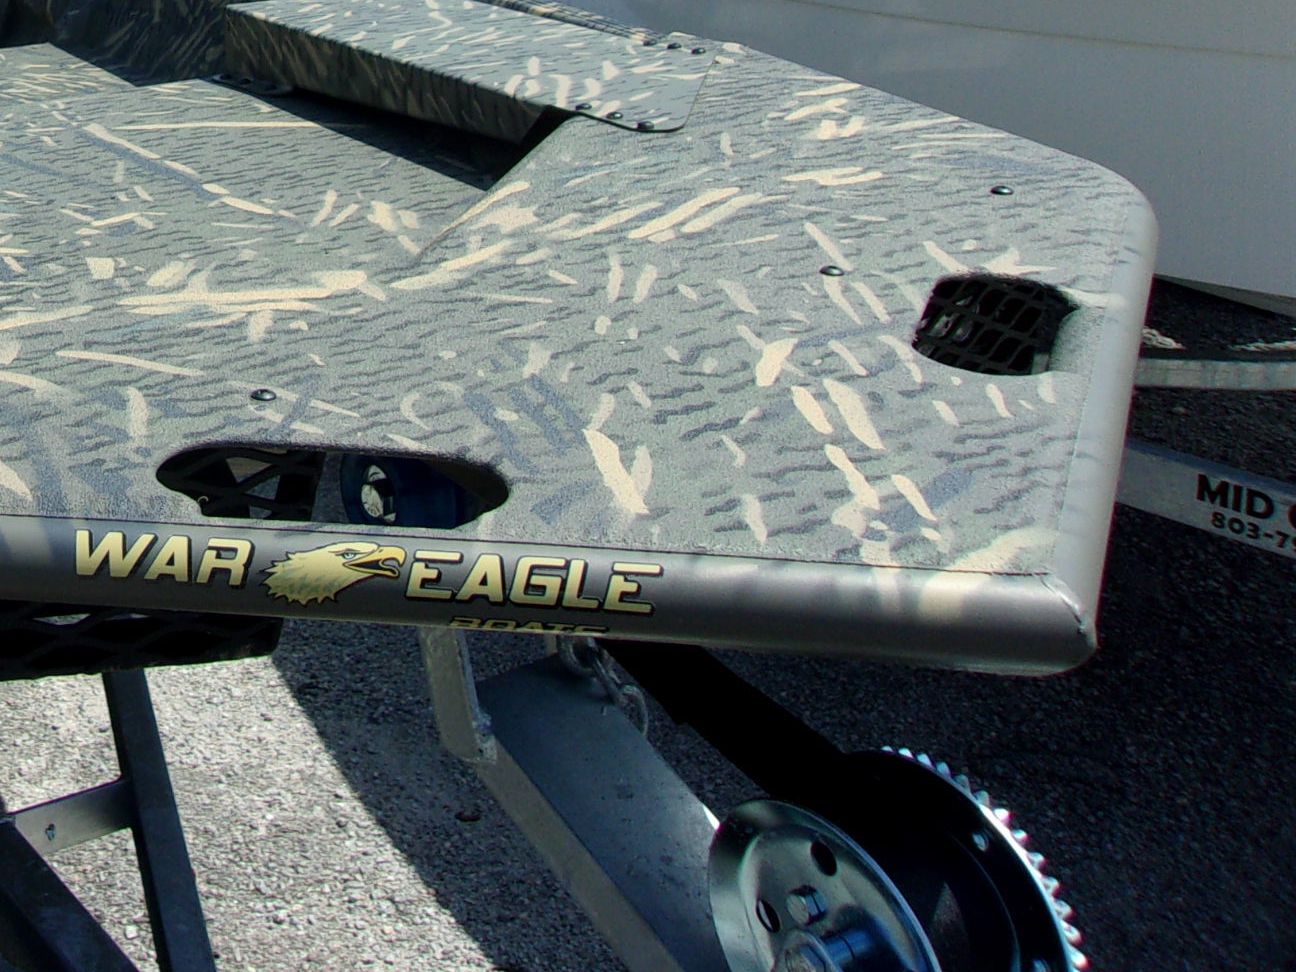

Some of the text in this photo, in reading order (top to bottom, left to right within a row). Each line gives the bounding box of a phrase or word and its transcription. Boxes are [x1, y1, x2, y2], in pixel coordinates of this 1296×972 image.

[1197, 474, 1274, 519] MID
[74, 530, 663, 615] WAR EAGLE
